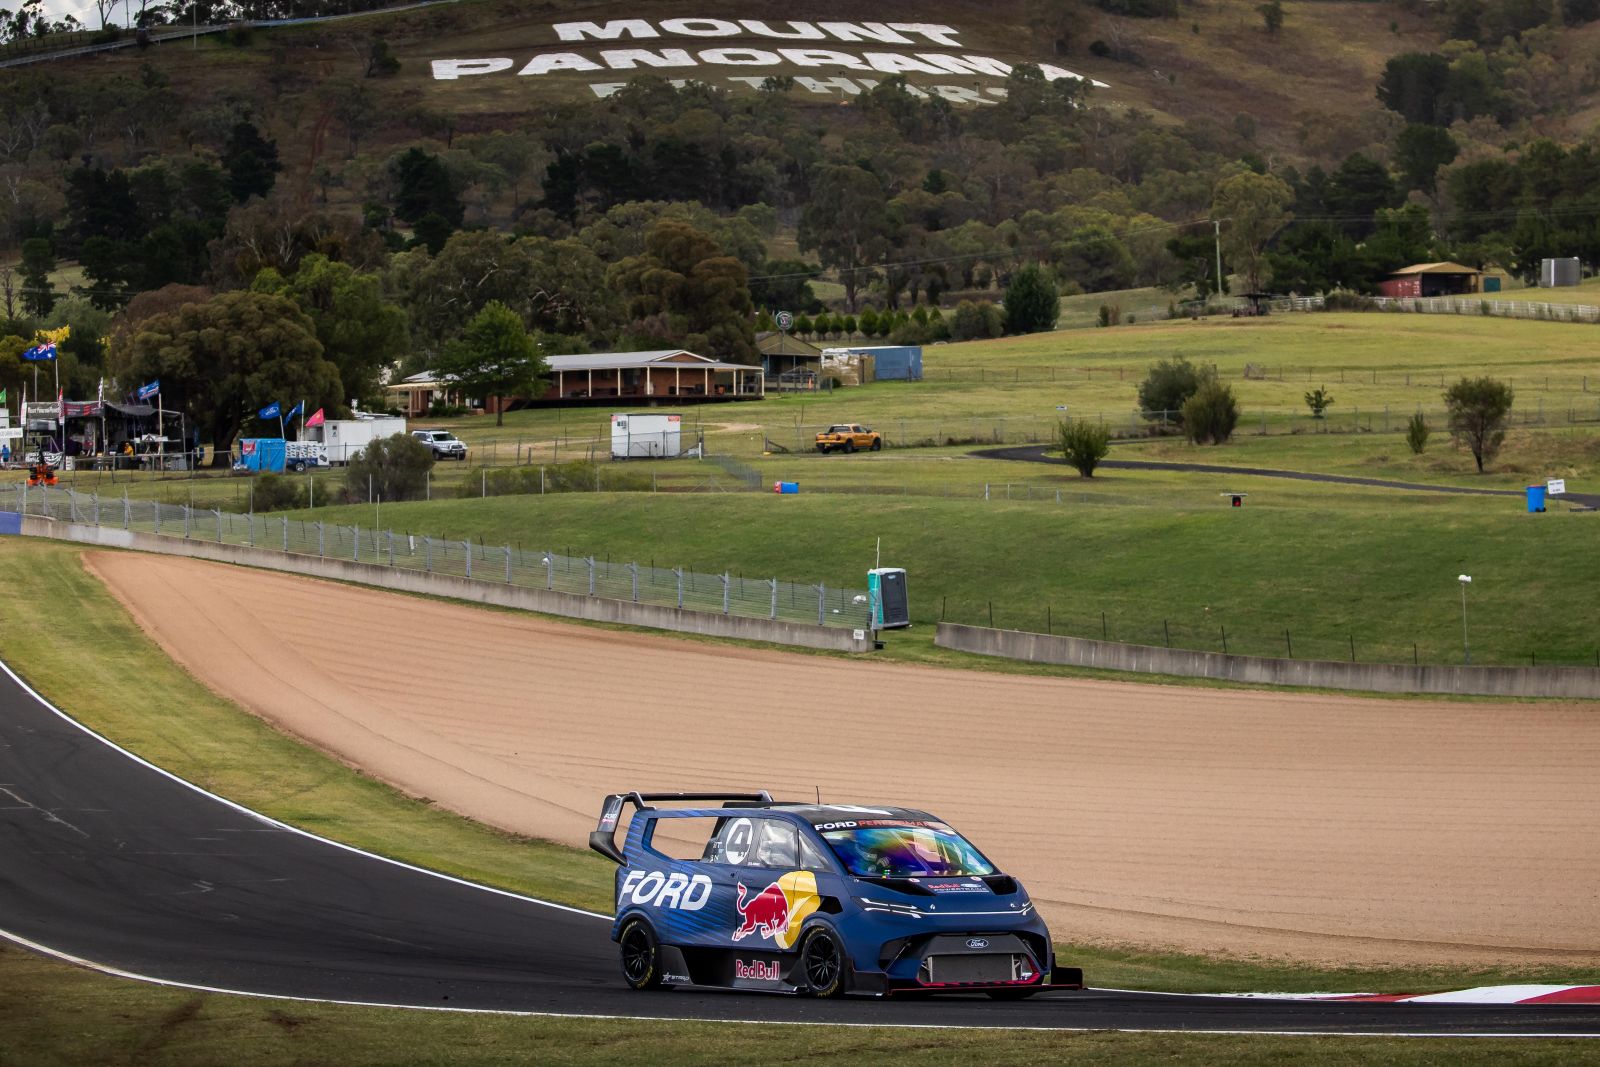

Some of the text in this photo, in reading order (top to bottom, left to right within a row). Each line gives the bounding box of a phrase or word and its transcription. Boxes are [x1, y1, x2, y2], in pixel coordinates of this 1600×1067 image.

[552, 18, 963, 47] MOUNT
[814, 821, 858, 831] FORD
[618, 870, 713, 911] FORD
[735, 959, 780, 981] Red Bull
